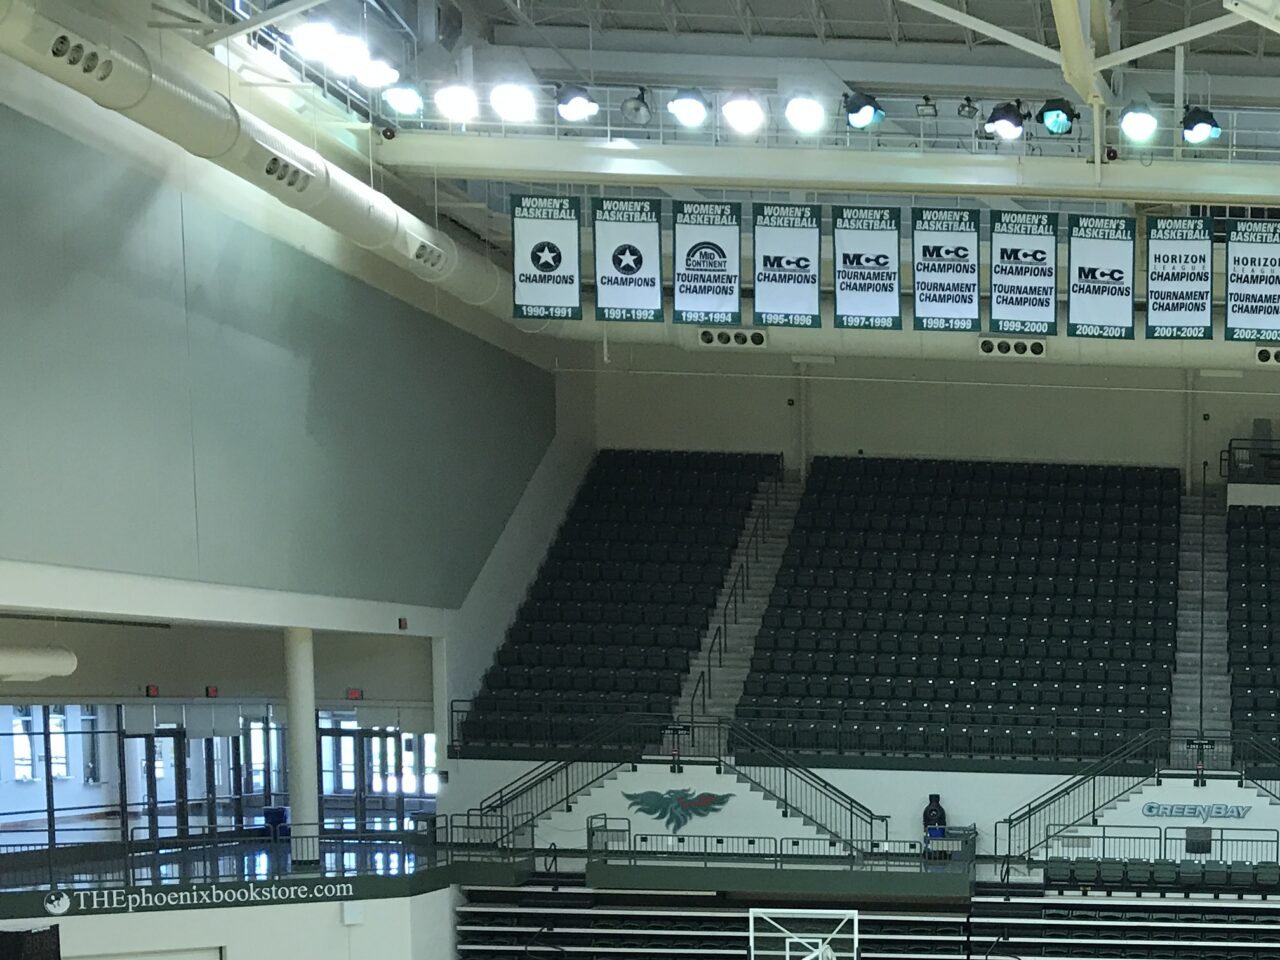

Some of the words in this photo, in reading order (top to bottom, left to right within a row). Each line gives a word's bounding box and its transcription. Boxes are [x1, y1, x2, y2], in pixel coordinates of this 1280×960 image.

[521, 198, 569, 208] WOMEN'S
[603, 200, 650, 211] WOMEN'S
[515, 207, 576, 219] BASKETBALL
[684, 204, 730, 215] WOMEN'S
[763, 206, 810, 217] WOMEN'S
[843, 209, 890, 220] WOMEN'S
[596, 210, 657, 222] BASKETBALL
[677, 213, 737, 225] BASKETBALL
[923, 210, 969, 221] WOMEN'S
[1001, 213, 1047, 224] WOMEN'S
[757, 216, 817, 227] BASKETBALL
[836, 219, 896, 230] BASKETBALL
[916, 221, 975, 231] BASKETBALL
[1079, 218, 1125, 229] WOMEN'S
[1157, 219, 1203, 230] WOMEN'S
[995, 223, 1054, 234] BASKETBALL
[1072, 227, 1131, 240] BASKETBALL
[1151, 229, 1210, 240] BASKETBALL
[1154, 254, 1206, 264] HORIZON
[916, 263, 976, 274] CHAMPIONS
[994, 266, 1053, 277] CHAMPIONS
[519, 273, 574, 284] CHAMPIONS
[600, 276, 655, 287] CHAMPIONS
[677, 273, 737, 284] TOURNAMENT
[757, 273, 816, 284] CHAMPIONS
[837, 270, 897, 282] TOURNAMENT
[1150, 271, 1209, 282] CHAMPIONS
[679, 285, 734, 295] CHAMPIONS
[840, 282, 894, 292] CHAMPIONS
[916, 282, 976, 293] TOURNAMENT
[993, 284, 1053, 296] TOURNAMENT
[1072, 284, 1130, 296] CHAMPIONS
[919, 293, 973, 304] CHAMPIONS
[1150, 290, 1209, 301] TOURNAMENT
[996, 296, 1050, 307] CHAMPIONS
[1152, 302, 1206, 312] CHAMPIONS
[522, 306, 572, 317] 1990-1991
[604, 309, 654, 320] 1991-1992
[681, 312, 732, 323] 1993-1994
[761, 314, 811, 325] 1995-1996
[842, 317, 892, 328] 1997-1998
[922, 319, 972, 329] 1998-1999
[998, 322, 1048, 332] 1999-2000
[1076, 325, 1125, 337] 2000-2001
[1154, 327, 1204, 338] 2001-2002
[73, 883, 354, 912] THEphoenixbookstore.com
